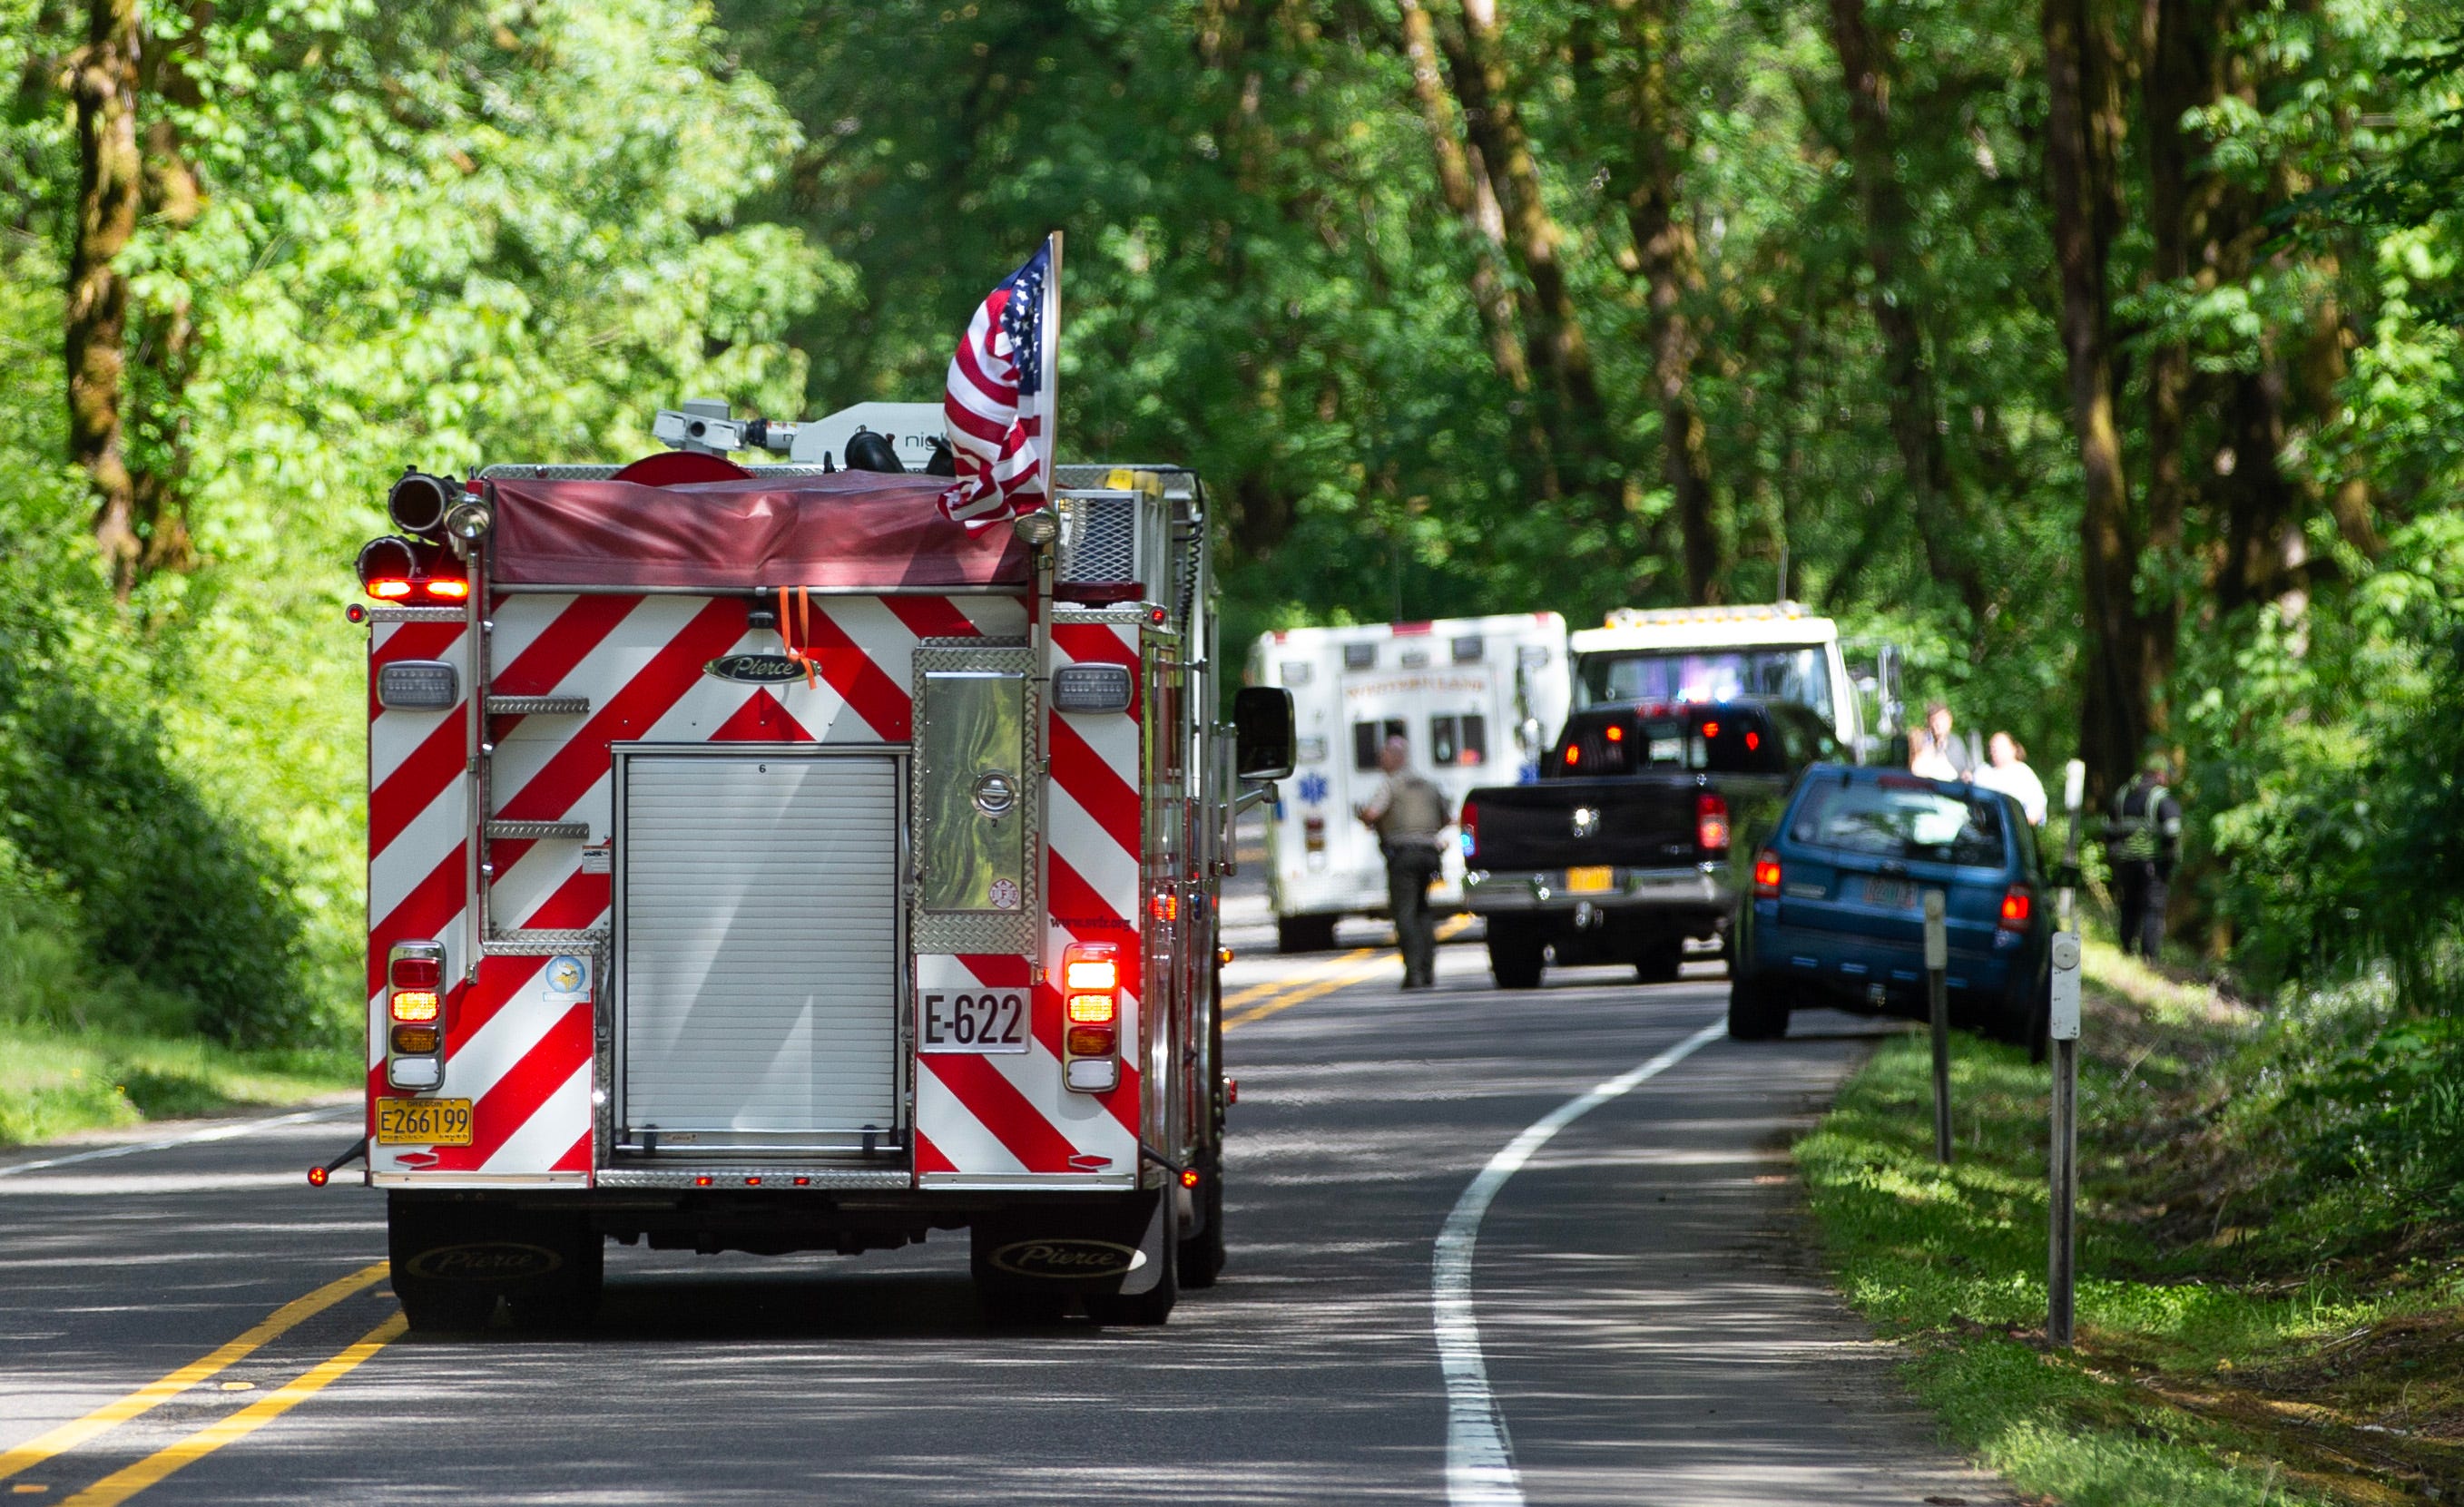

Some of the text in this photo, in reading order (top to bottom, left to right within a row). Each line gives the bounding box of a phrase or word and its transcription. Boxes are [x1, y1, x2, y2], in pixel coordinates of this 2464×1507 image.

[732, 657, 796, 678] Pierce
[759, 764, 767, 774] 6
[926, 994, 1023, 1044] E-622
[381, 1108, 468, 1134] E266199
[1017, 1246, 1115, 1267] Pierce
